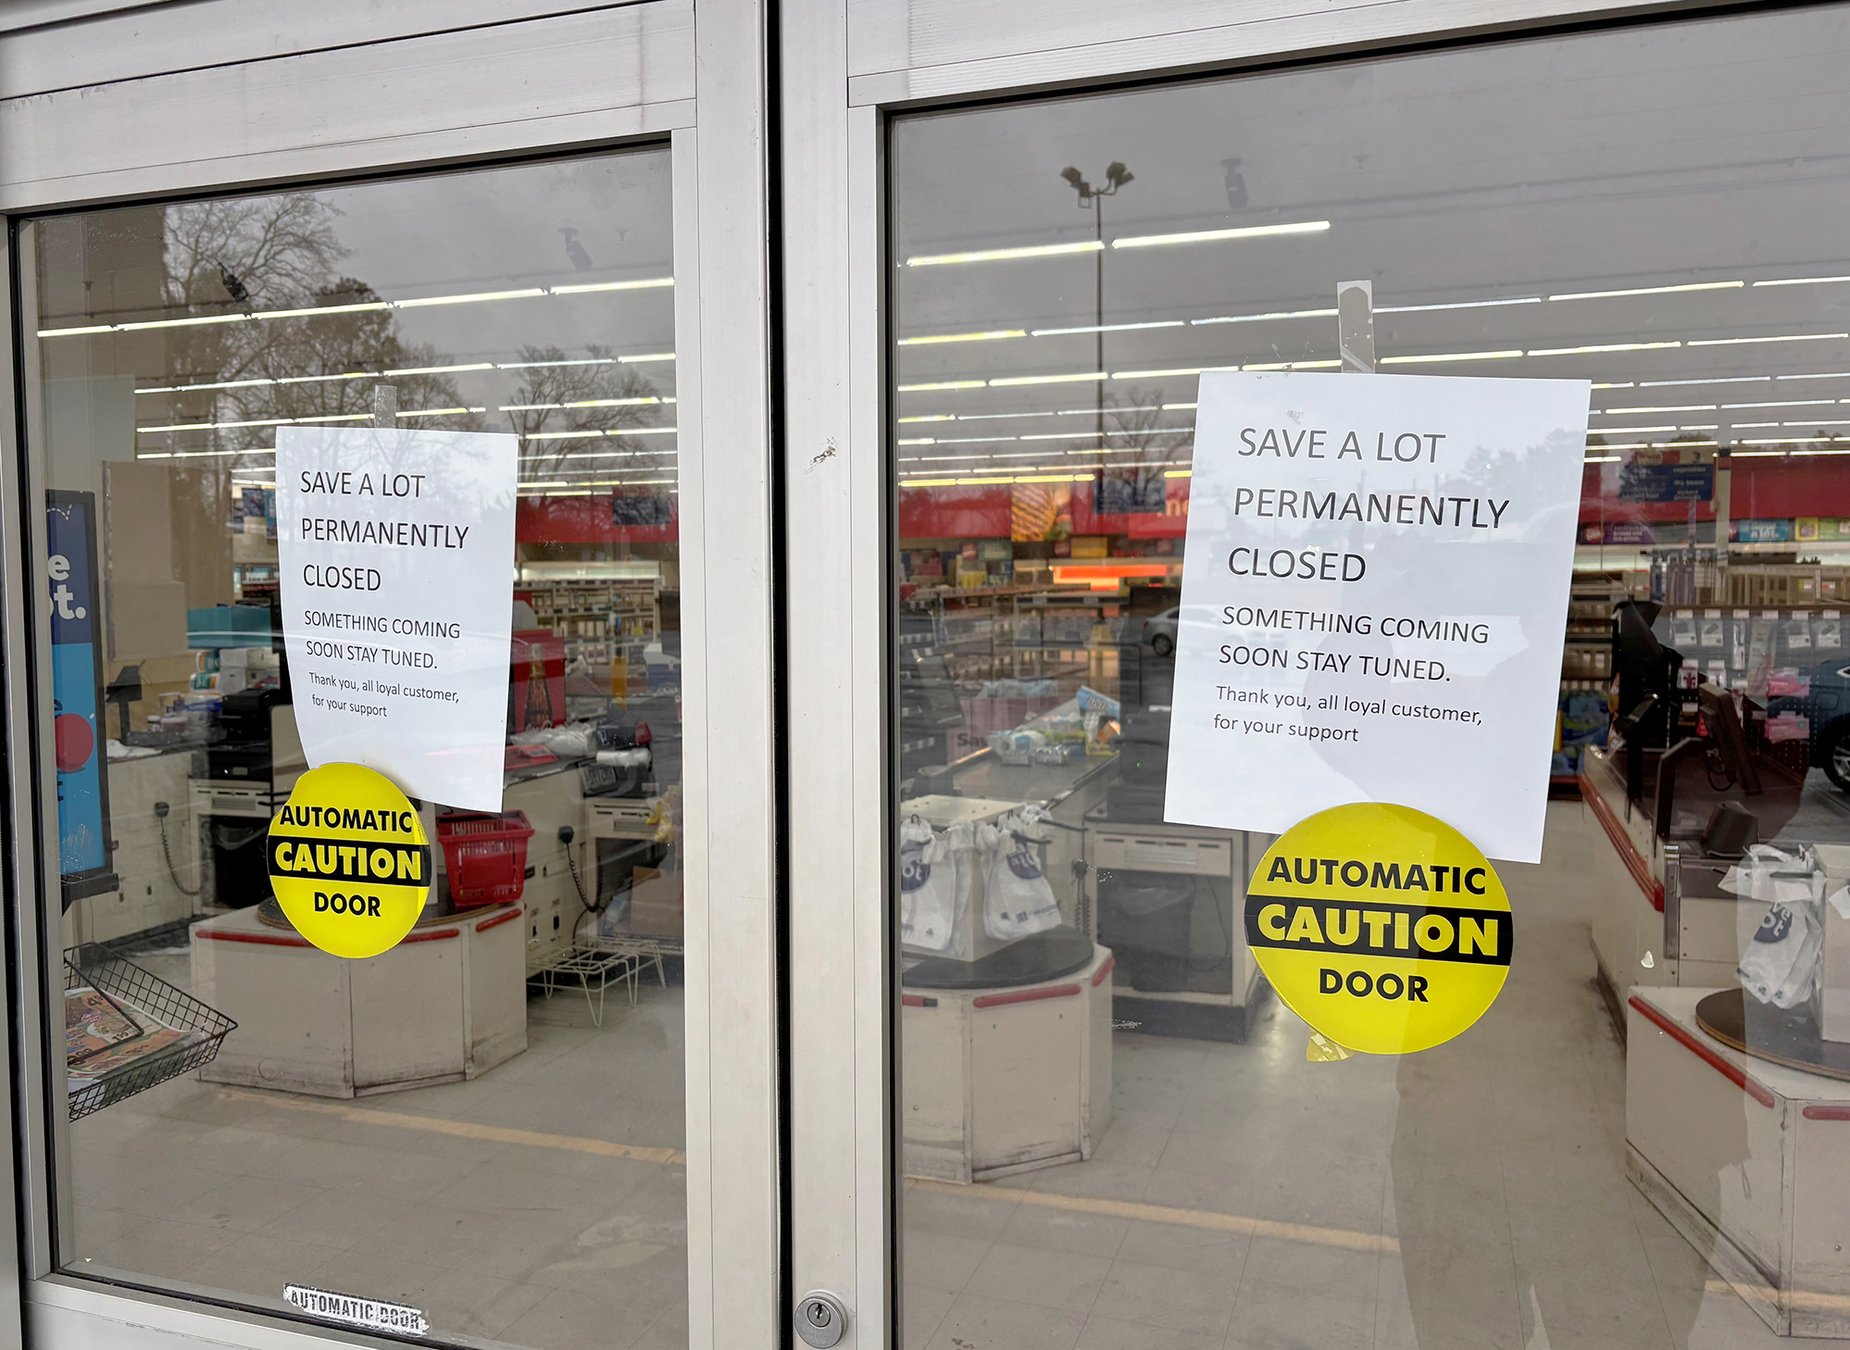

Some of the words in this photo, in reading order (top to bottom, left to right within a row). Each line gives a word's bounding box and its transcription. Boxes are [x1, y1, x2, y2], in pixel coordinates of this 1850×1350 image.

[1238, 428, 1327, 458] SAVE
[1337, 431, 1362, 460] A
[1377, 432, 1446, 463] LOT
[301, 471, 352, 494] SAVE
[358, 473, 374, 496] A
[383, 474, 425, 498] LOT
[1235, 488, 1509, 529] PERMANENTLY
[302, 518, 469, 549] PERMANENTLY
[304, 564, 381, 591] CLOSED
[1229, 547, 1366, 582] CLOSED
[305, 610, 387, 633] SOMETHING
[392, 619, 460, 639] COMING
[1222, 606, 1372, 637] SOMETHING
[1379, 618, 1489, 643] COMING
[306, 641, 343, 659] SOON
[347, 645, 378, 663] STAY
[382, 649, 437, 669] TUNED.
[1219, 645, 1288, 668] SOON
[1296, 651, 1352, 673] STAY
[1359, 656, 1450, 681] TUNED.
[309, 672, 337, 687] Thank
[338, 679, 359, 692] you,
[362, 680, 373, 692] all
[376, 681, 400, 696] loyal
[403, 687, 459, 703] customer,
[312, 694, 324, 706] for
[326, 699, 347, 710] your
[349, 703, 387, 717] support
[1216, 686, 1269, 704] Thank
[1274, 694, 1311, 710] you,
[1318, 695, 1338, 712] all
[1344, 696, 1386, 716] loyal
[1392, 705, 1481, 726] customer,
[1214, 714, 1238, 730] for
[1243, 721, 1283, 734] your
[1288, 725, 1359, 742] support
[279, 805, 413, 833] AUTOMATIC
[275, 842, 421, 880] CAUTION
[1267, 856, 1486, 895] AUTOMATIC
[314, 892, 381, 917] DOOR
[1257, 904, 1498, 956] CAUTION
[1319, 968, 1429, 1002] DOOR
[291, 1290, 374, 1320] AUTOMATIC
[379, 1307, 421, 1331] DOOR
